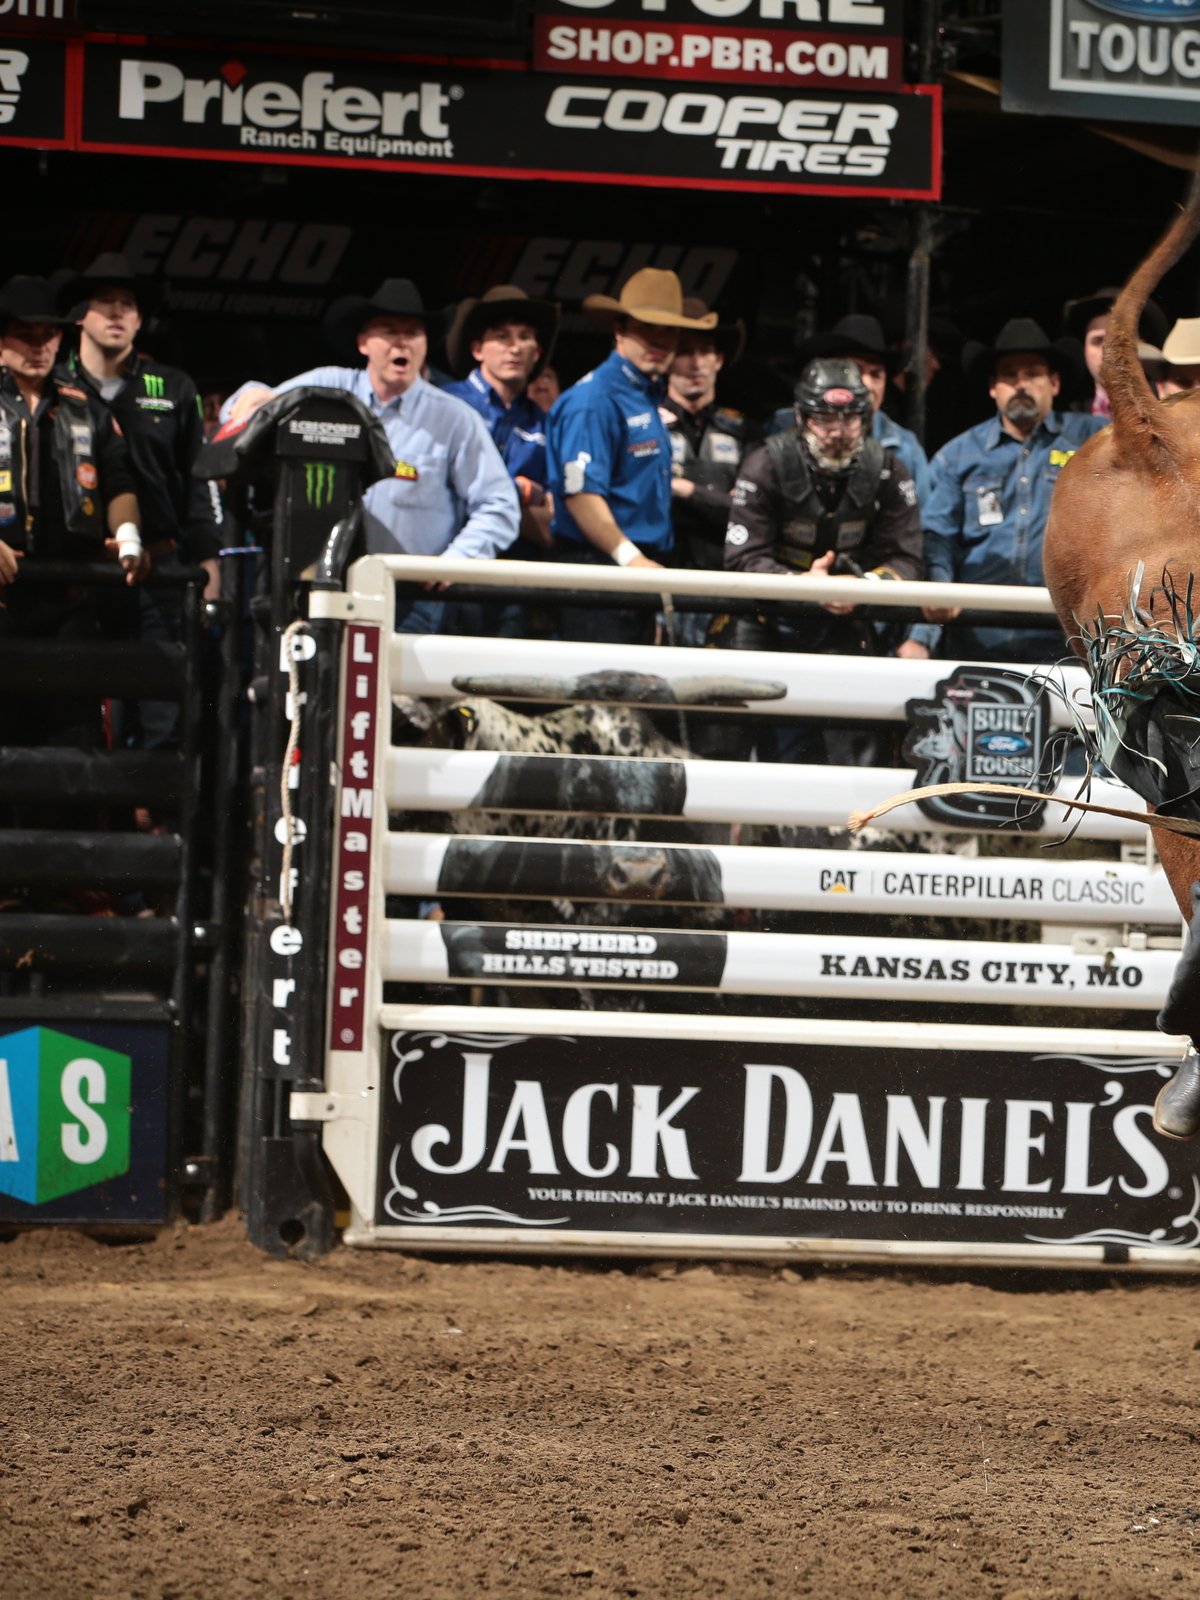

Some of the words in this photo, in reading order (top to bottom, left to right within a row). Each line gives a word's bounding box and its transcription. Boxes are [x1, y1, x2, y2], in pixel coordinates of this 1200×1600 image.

[547, 26, 889, 80] SHOP.PBR.COM
[118, 58, 450, 139] Priefert
[544, 85, 899, 146] COOPER
[240, 125, 316, 150] Ranch
[324, 133, 454, 159] Equipment
[714, 138, 889, 177] TIRES
[974, 709, 1034, 733] BUILT
[820, 869, 858, 892] CAT
[884, 872, 1043, 900] CATERPILLAR
[1052, 878, 1145, 905] CLASSIC
[505, 930, 658, 955] SHEPHERD
[482, 953, 567, 975] HILLS
[569, 957, 680, 980] TESTED
[820, 954, 970, 981] KANSAS
[981, 961, 1076, 989] CITY,
[1086, 964, 1143, 987] MO
[411, 1052, 701, 1180] JACK
[737, 1063, 1170, 1199] DANIEL'S
[527, 1187, 573, 1201] YOUR
[575, 1188, 643, 1203] FRIENDS
[645, 1190, 665, 1204] AT
[666, 1191, 707, 1208] JACK
[710, 1193, 781, 1209] DANIEL'S
[782, 1196, 847, 1212] REMIND
[849, 1199, 884, 1213] YOU
[886, 1200, 908, 1214] TO
[910, 1201, 962, 1217] DRINK
[964, 1203, 1067, 1220] RESPONSIBLY
